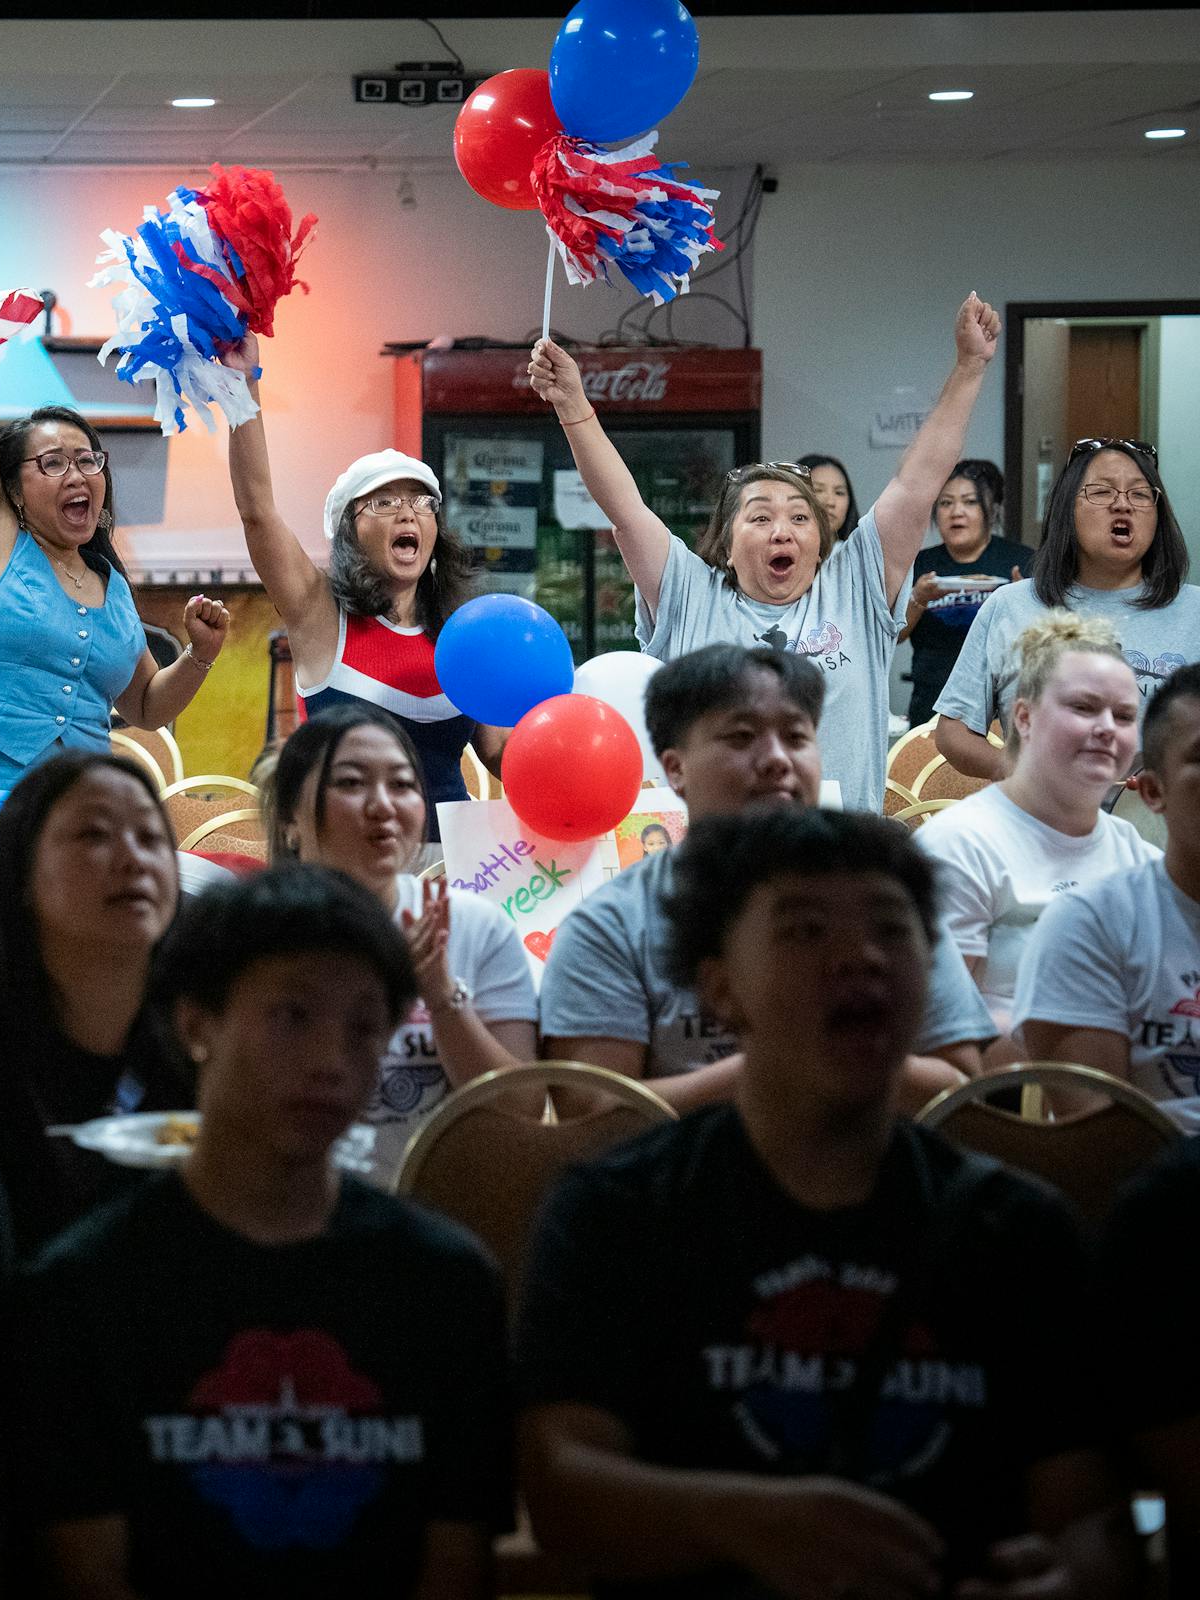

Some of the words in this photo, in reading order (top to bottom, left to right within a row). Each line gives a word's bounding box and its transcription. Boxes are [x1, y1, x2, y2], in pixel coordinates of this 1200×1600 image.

[875, 411, 925, 431] WATE
[501, 859, 572, 922] reek
[142, 1412, 273, 1462] TEAM
